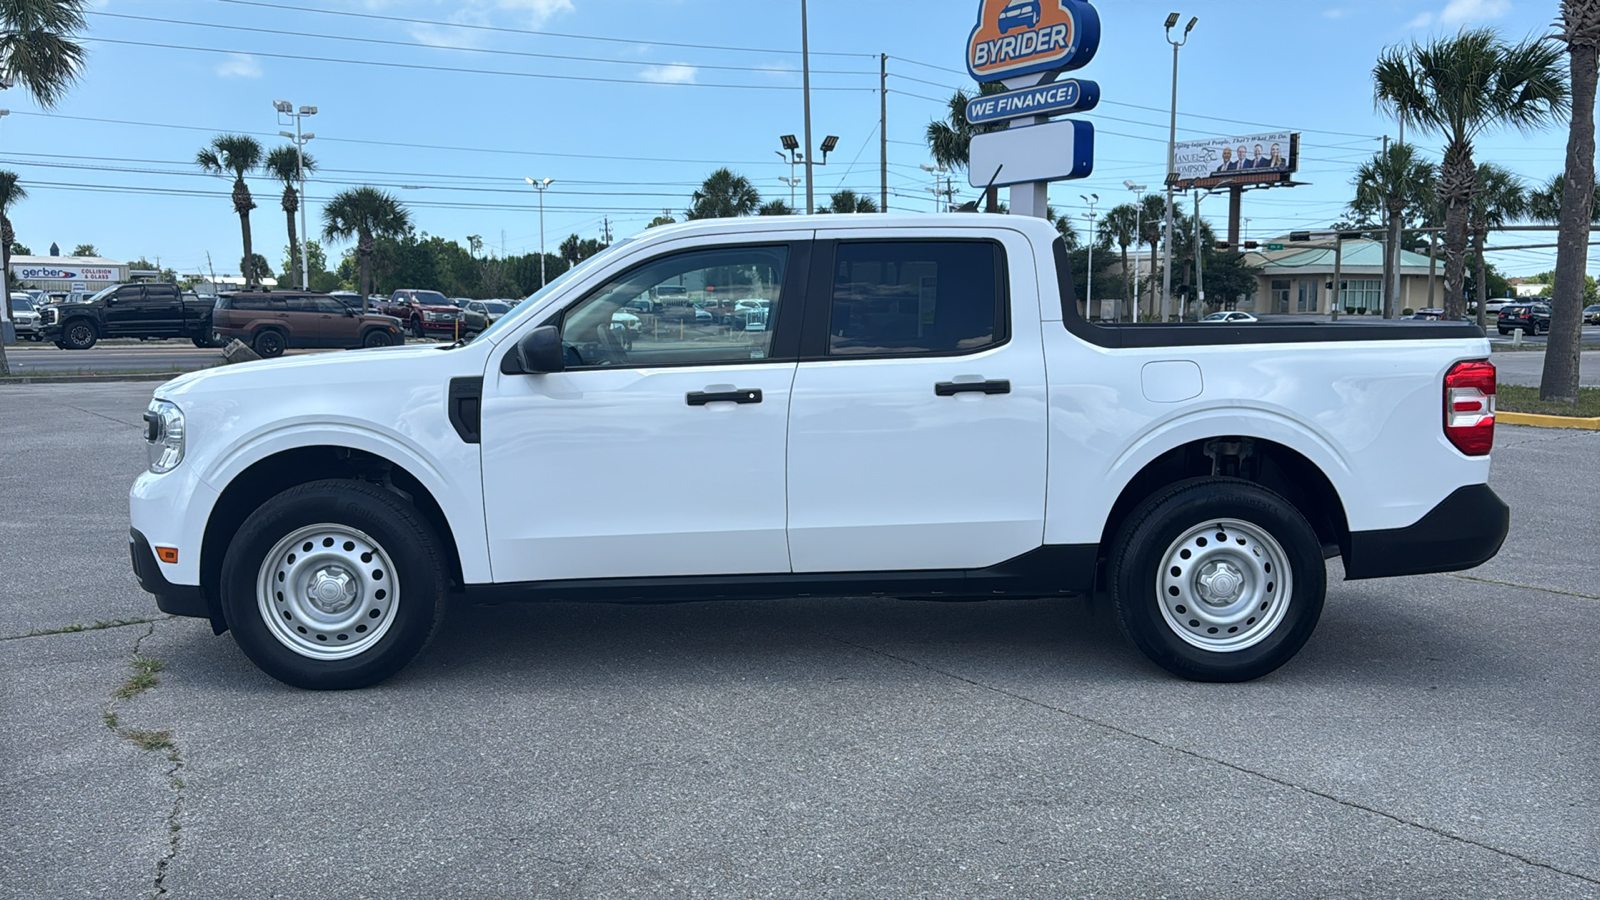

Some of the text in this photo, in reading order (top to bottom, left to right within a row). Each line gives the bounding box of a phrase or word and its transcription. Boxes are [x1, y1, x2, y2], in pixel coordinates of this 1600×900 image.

[974, 24, 1068, 66] BYRIDER
[971, 86, 1074, 117] WE FINANCE!
[1174, 164, 1208, 173] HOMPSON
[22, 267, 64, 279] gerber
